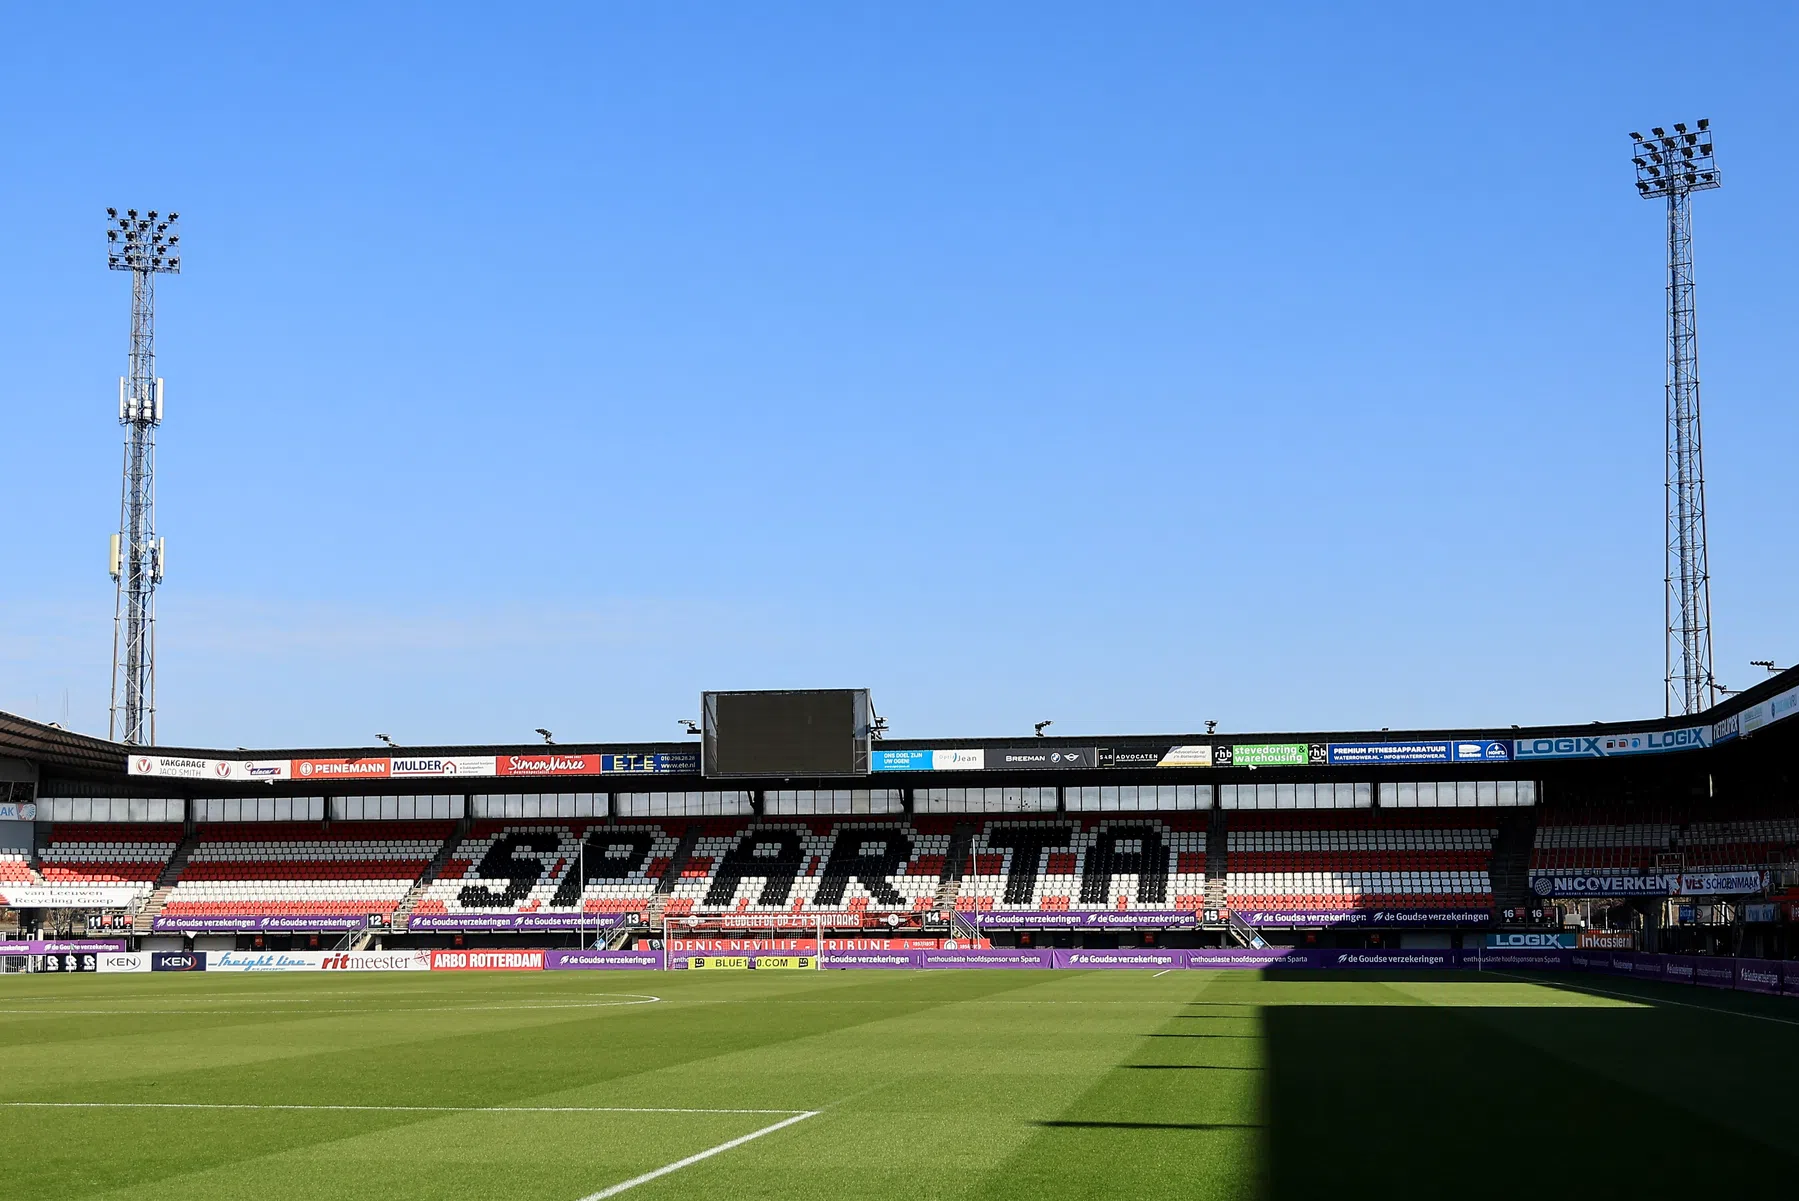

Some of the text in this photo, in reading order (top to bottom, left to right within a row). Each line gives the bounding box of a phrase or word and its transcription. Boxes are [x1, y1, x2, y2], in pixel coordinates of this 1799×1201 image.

[1647, 728, 1703, 748] LOGIX
[1234, 745, 1305, 755] stevedoring &
[1309, 747, 1326, 756] rhb
[1368, 745, 1446, 754] FITNESSAPPARATUUR
[1517, 738, 1601, 755] LOGIX
[1215, 749, 1232, 758] rhb
[1235, 753, 1303, 763] warehousing
[160, 759, 206, 768] VAKGARAGE
[393, 760, 442, 772] MULDER
[508, 756, 585, 771] Simon Maree
[613, 755, 654, 770] ETE
[159, 767, 201, 777] JACO SMITH
[315, 763, 385, 774] PEINEMANN
[458, 825, 1171, 907] SPARTA
[1554, 876, 1669, 891] NICOVERKEN
[14, 897, 114, 905] Recycling Groep
[925, 912, 940, 923] 14
[1204, 911, 1218, 922] 15
[1263, 912, 1367, 924] de Goudse verzekeringen
[1384, 912, 1489, 923] de Goudse verzekeringen
[1503, 909, 1514, 918] 16
[1531, 909, 1543, 918] 16
[89, 916, 101, 927] 11
[113, 916, 124, 927] 11
[166, 918, 256, 928] de Goudse verzekeringen
[270, 918, 360, 927] de Goudse verzekeringen
[369, 915, 382, 925] 12
[421, 917, 511, 928] de Goudse verzekeringen
[524, 917, 614, 928] de Goudse verzekeringen
[626, 914, 639, 924] 13
[984, 914, 1081, 925] de Goudse verzekeringen
[1097, 914, 1195, 925] de Goudse verzekeringen
[1496, 934, 1561, 946] LOGIX
[80, 944, 120, 952] verzekeringen
[674, 940, 722, 951] DENIS
[731, 940, 797, 951] NEVILLE
[819, 940, 891, 951] TRIBUNE
[107, 957, 136, 966] KEN
[161, 957, 193, 966] KEN
[217, 952, 306, 971] freight line
[321, 953, 410, 970] ritmeester
[434, 953, 542, 968] ARBO ROTTERDAM
[569, 956, 656, 965] de Goudse verzekeringen
[830, 955, 857, 963] Goudse
[858, 955, 910, 965] verzekeringen
[966, 956, 1008, 964] hoofdsponsor
[1020, 956, 1041, 964] Sparta
[1079, 955, 1172, 965] de Goudse verzekeringen
[1190, 955, 1230, 963] enthousiaste
[1231, 955, 1275, 964] hoofdsponsor
[1287, 955, 1308, 964] Sparta
[1348, 955, 1444, 965] de Goudse verzekeringen
